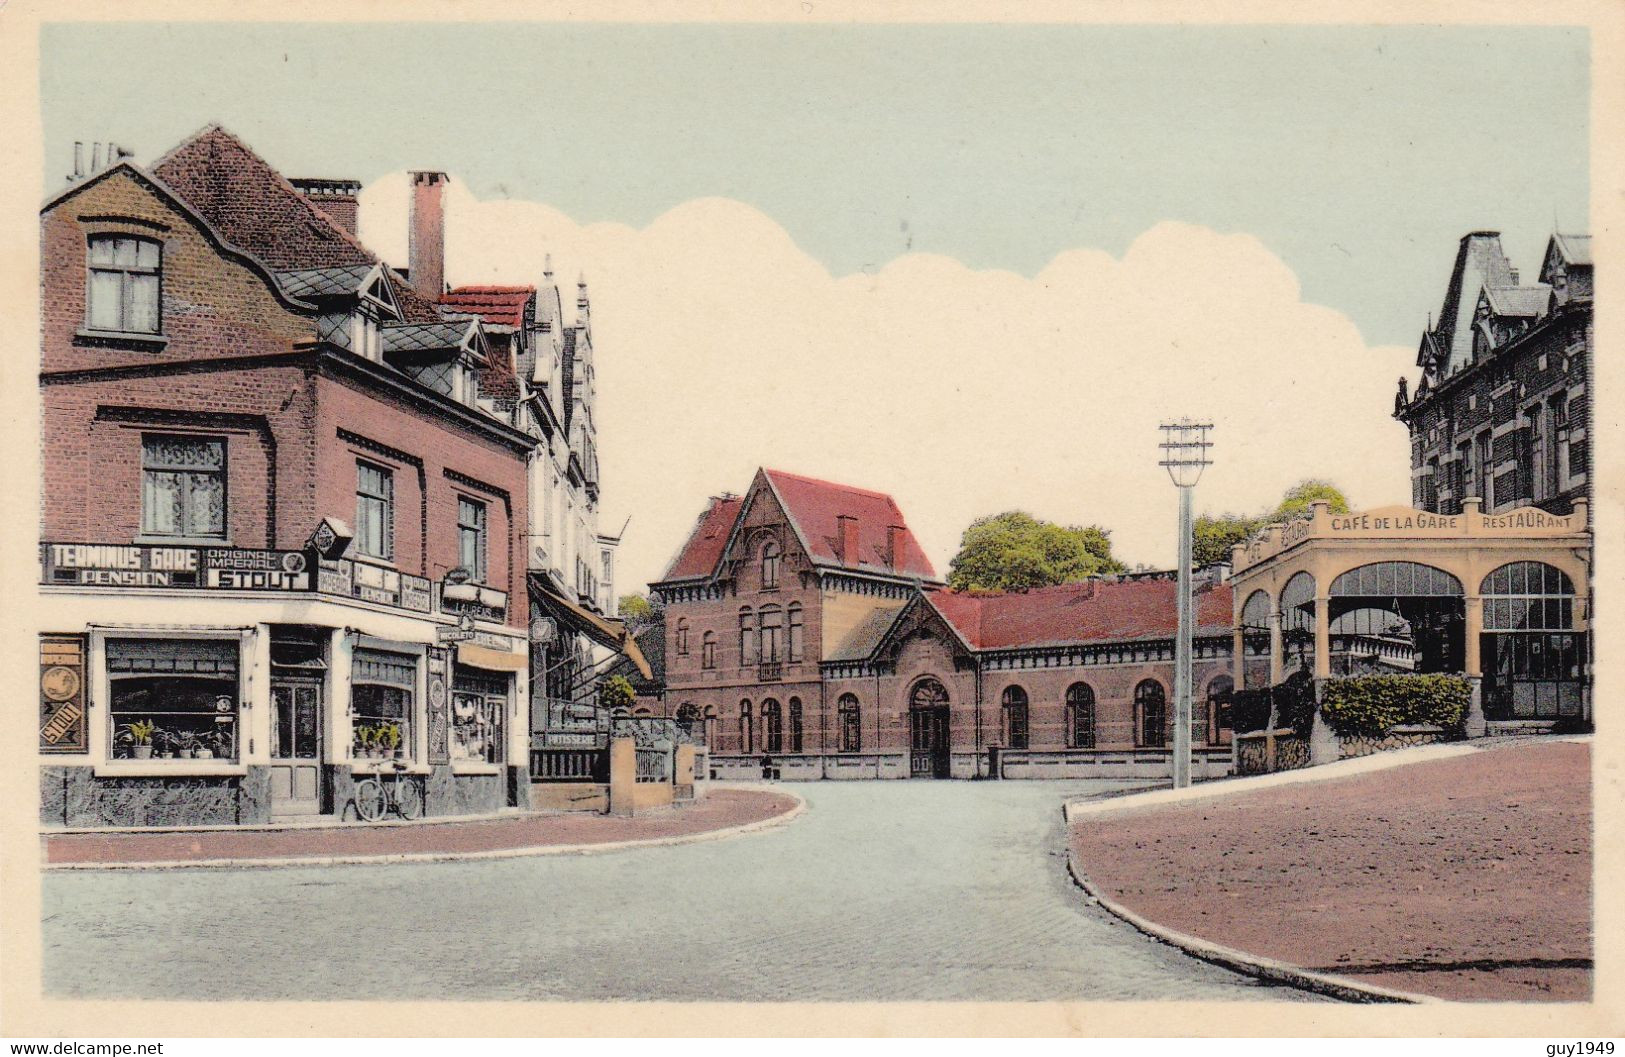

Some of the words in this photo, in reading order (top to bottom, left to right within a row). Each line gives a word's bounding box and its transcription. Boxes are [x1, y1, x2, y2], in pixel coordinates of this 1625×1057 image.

[1332, 514, 1369, 530] CAFÉ
[1374, 518, 1390, 529] DE
[1396, 517, 1413, 529] LA
[1417, 513, 1458, 529] GARE
[52, 544, 142, 570] TERMINUS
[150, 547, 198, 571] GARE
[207, 548, 277, 561] ORIGINAL
[207, 558, 277, 570] IMPERIAL
[81, 571, 169, 586] PENSION
[219, 570, 300, 589] STOUT
[43, 703, 80, 744] STOUT
